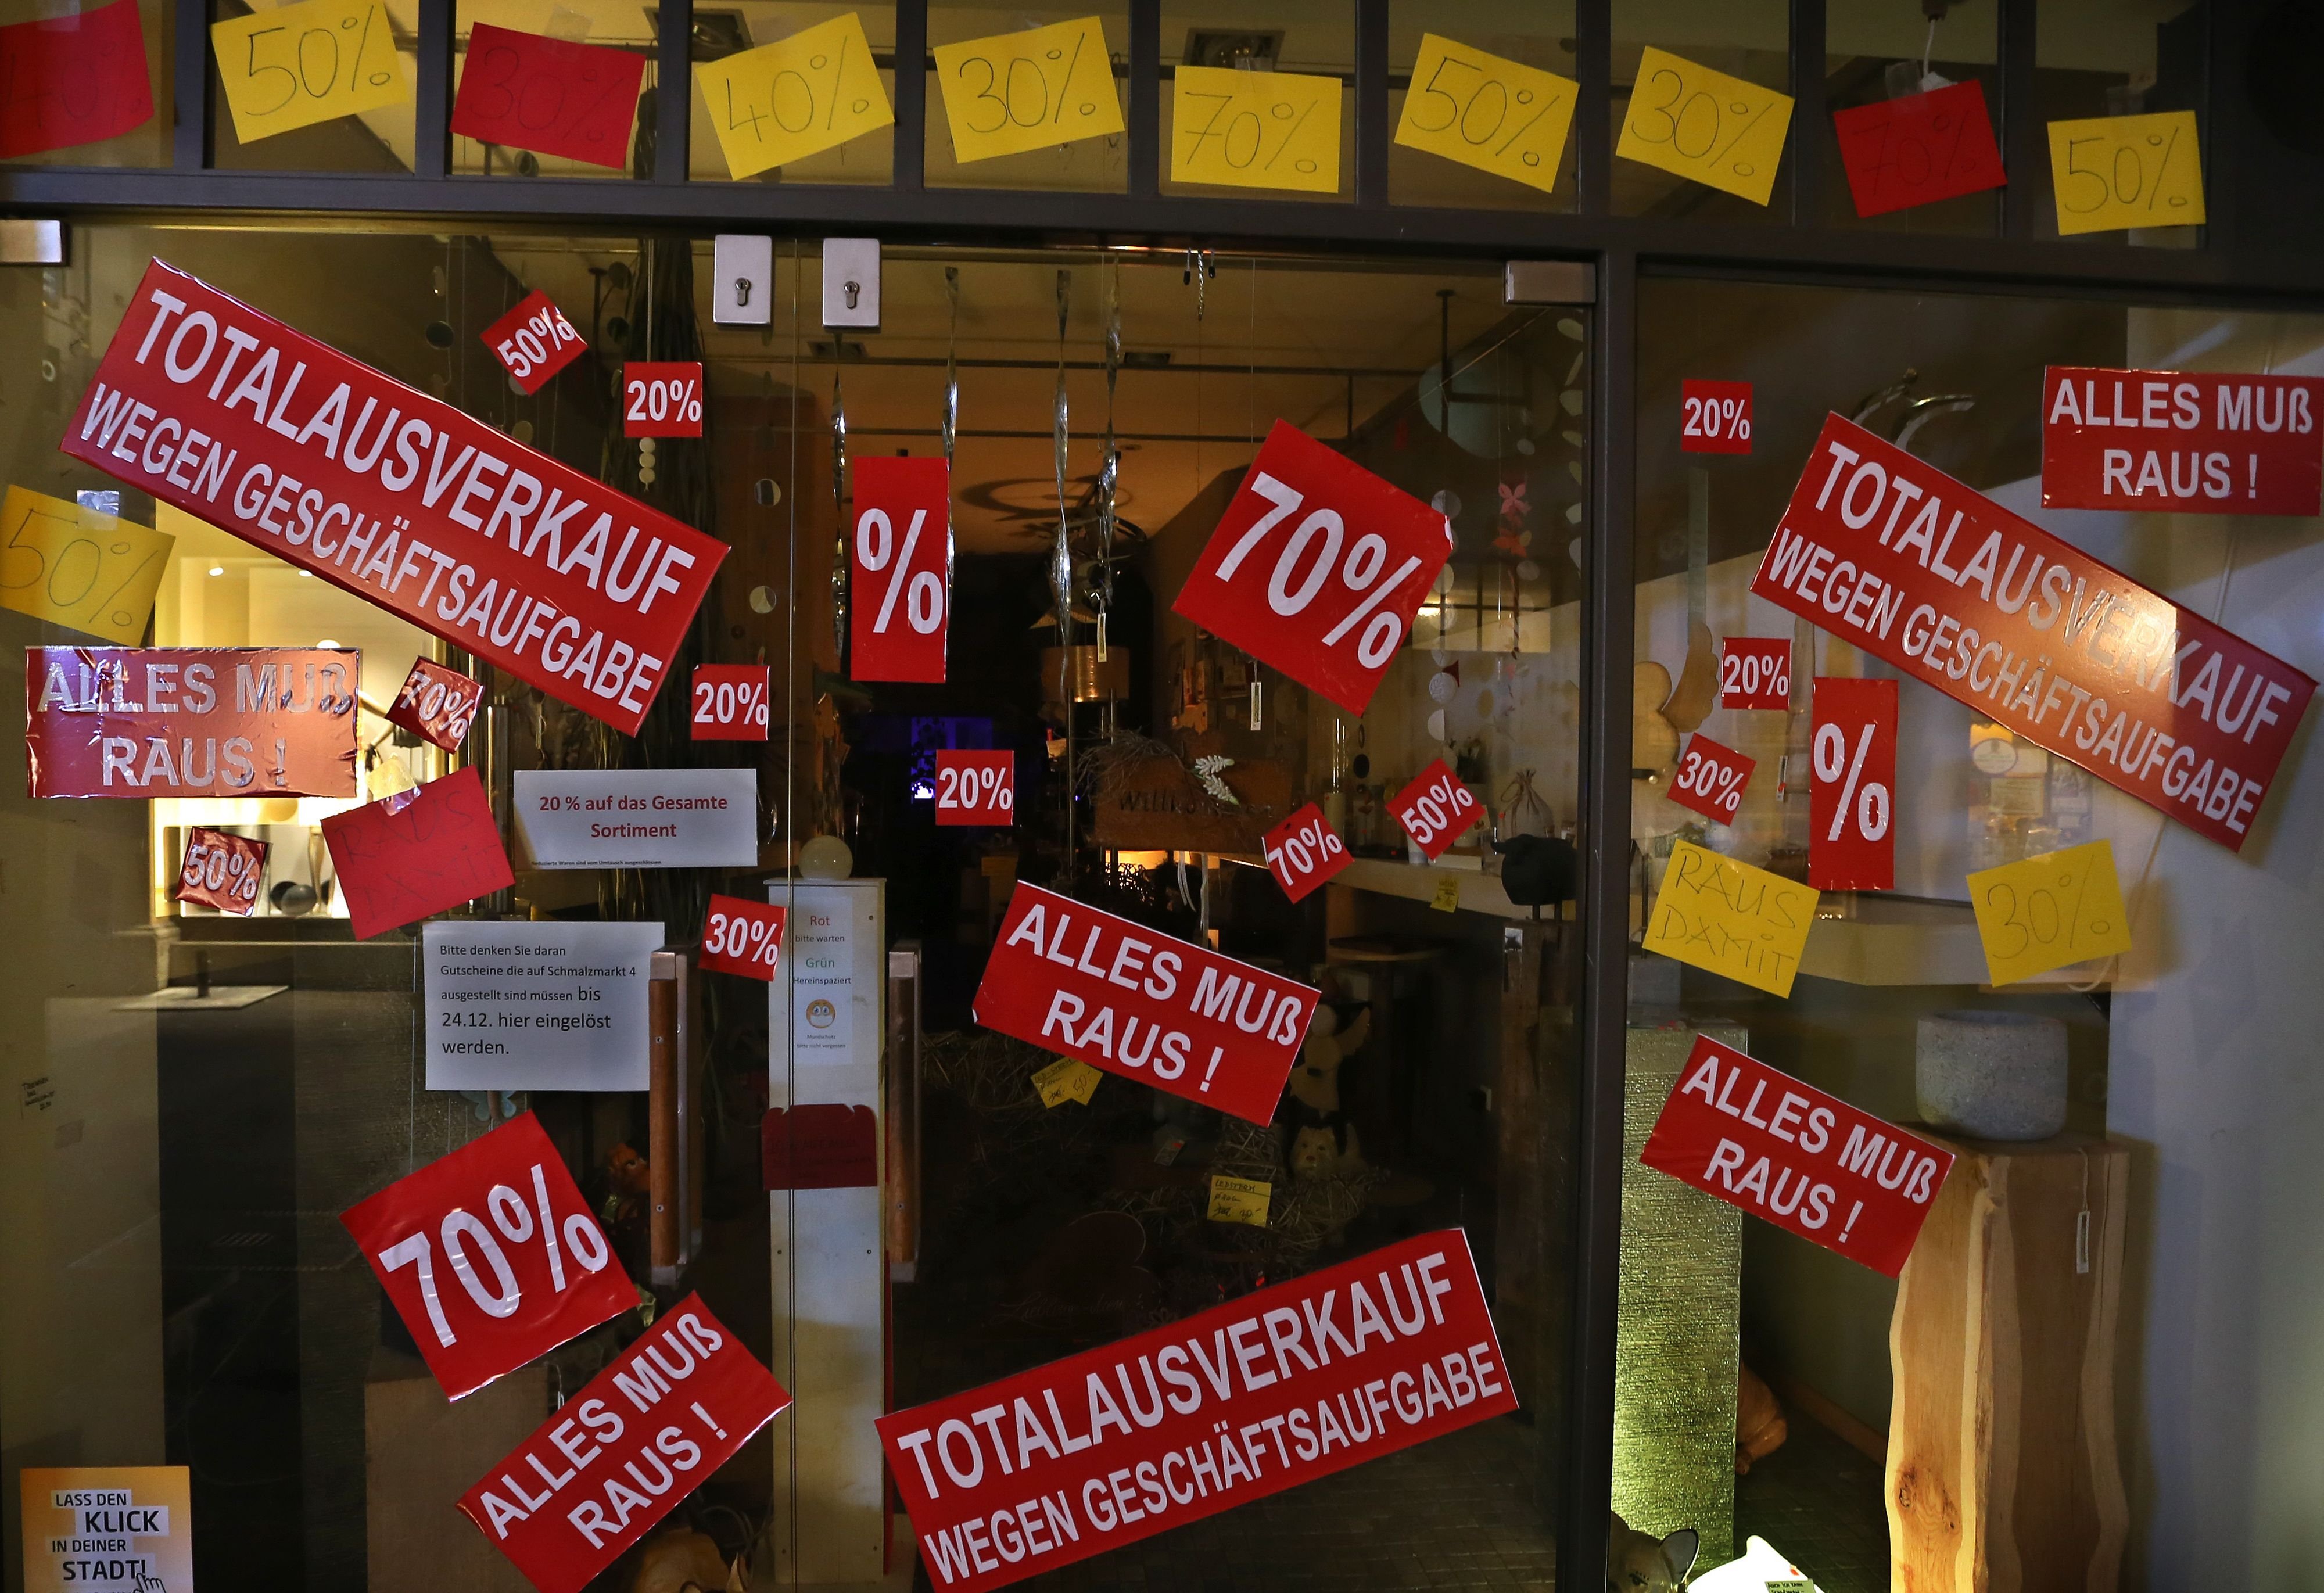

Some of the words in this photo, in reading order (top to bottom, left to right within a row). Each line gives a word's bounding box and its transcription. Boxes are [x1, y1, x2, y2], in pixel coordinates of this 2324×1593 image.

[244, 5, 390, 116] 50%
[468, 46, 624, 143] 30%
[726, 36, 869, 142] 40%
[960, 32, 1096, 133] 30%
[1184, 92, 1318, 173] 70%
[1410, 56, 1561, 166] 50%
[1631, 69, 1774, 177] 30%
[1852, 110, 1977, 196] 70%
[2064, 127, 2188, 213] 50%
[497, 307, 575, 378] 50%
[627, 379, 701, 422] 20%
[1684, 397, 1751, 440] 20%
[2049, 379, 2200, 430] ALLES
[2217, 385, 2313, 433] MUß
[135, 289, 695, 615] TOTALAUSVERKAUF
[2103, 449, 2231, 498] RAUS
[2248, 454, 2258, 499] !
[0, 508, 159, 626] 50%
[80, 382, 237, 503] WEGEN
[234, 463, 662, 715] GESCHÄFTSAUFGABE
[856, 508, 943, 634] %
[1215, 471, 1422, 669] 70%
[1815, 441, 2291, 744] TOTALAUSVERKAUF
[37, 662, 216, 713] ALLES
[236, 662, 351, 715] MUß
[400, 671, 476, 739] 70%
[694, 682, 768, 726] 20%
[1723, 654, 1789, 696] 20%
[1769, 528, 1905, 640] WEGEN
[1902, 604, 2262, 834] GESCHÄFTSAUFGABE
[102, 737, 254, 788] RAUS
[938, 767, 1012, 810] 20%
[1677, 752, 1744, 812] 30%
[1813, 723, 1889, 842] %
[335, 791, 474, 864] RAUS
[540, 796, 560, 811] 20
[566, 796, 580, 811] %
[585, 795, 613, 810] auf
[618, 795, 647, 810] das
[652, 795, 727, 810] Gesamte
[591, 823, 677, 838] Sortiment
[1401, 774, 1473, 844] 50%
[184, 843, 257, 900] 50%
[1268, 819, 1343, 886] 70%
[810, 915, 830, 926] Rot
[1676, 848, 1799, 928] RAUS
[1988, 853, 2111, 960] 30%
[440, 945, 467, 956] Bitte
[470, 945, 511, 956] denken
[514, 945, 531, 956] Sie
[534, 945, 566, 956] daran
[440, 965, 504, 977] Gutscheine
[507, 966, 523, 977] die
[527, 966, 545, 977] auf
[548, 966, 626, 977] Schmalzmarkt
[629, 967, 636, 977] 4
[705, 913, 779, 966] 30%
[795, 934, 815, 942] bitte
[806, 957, 835, 968] Grün
[441, 990, 501, 1003] ausgestellt
[504, 990, 526, 1000] sind
[530, 990, 572, 1001] müssen
[578, 986, 601, 1002] bis
[793, 977, 852, 985] Hereinspaziert
[1006, 903, 1182, 1000] ALLES
[1190, 967, 1303, 1046] MUß
[442, 1012, 493, 1028] 24.12.
[498, 1013, 530, 1028] hier
[535, 1013, 611, 1031] eingelöst
[442, 1039, 510, 1054] werden.
[1041, 989, 1191, 1081] RAUS
[1199, 1046, 1224, 1092] !
[1681, 1055, 1835, 1154] ALLES
[1838, 1125, 1938, 1204] MUß
[1703, 1138, 1837, 1230] RAUS
[1838, 1200, 1864, 1243] !
[378, 1164, 608, 1348] 70%
[897, 1252, 1452, 1499] TOTALAUSVERKAUF
[480, 1398, 624, 1540] ALLES
[612, 1313, 723, 1413] MUß
[567, 1426, 701, 1549] RAUS
[690, 1402, 727, 1441] !
[924, 1490, 1079, 1584] WEGEN
[1082, 1341, 1502, 1531] GESCHÄFTSAUFGABE
[56, 1494, 92, 1506] LASS
[96, 1494, 127, 1506] DEN
[85, 1511, 160, 1533] KLICK
[52, 1540, 67, 1553] IN
[72, 1539, 126, 1552] DEINER
[63, 1560, 146, 1581] STADT!
